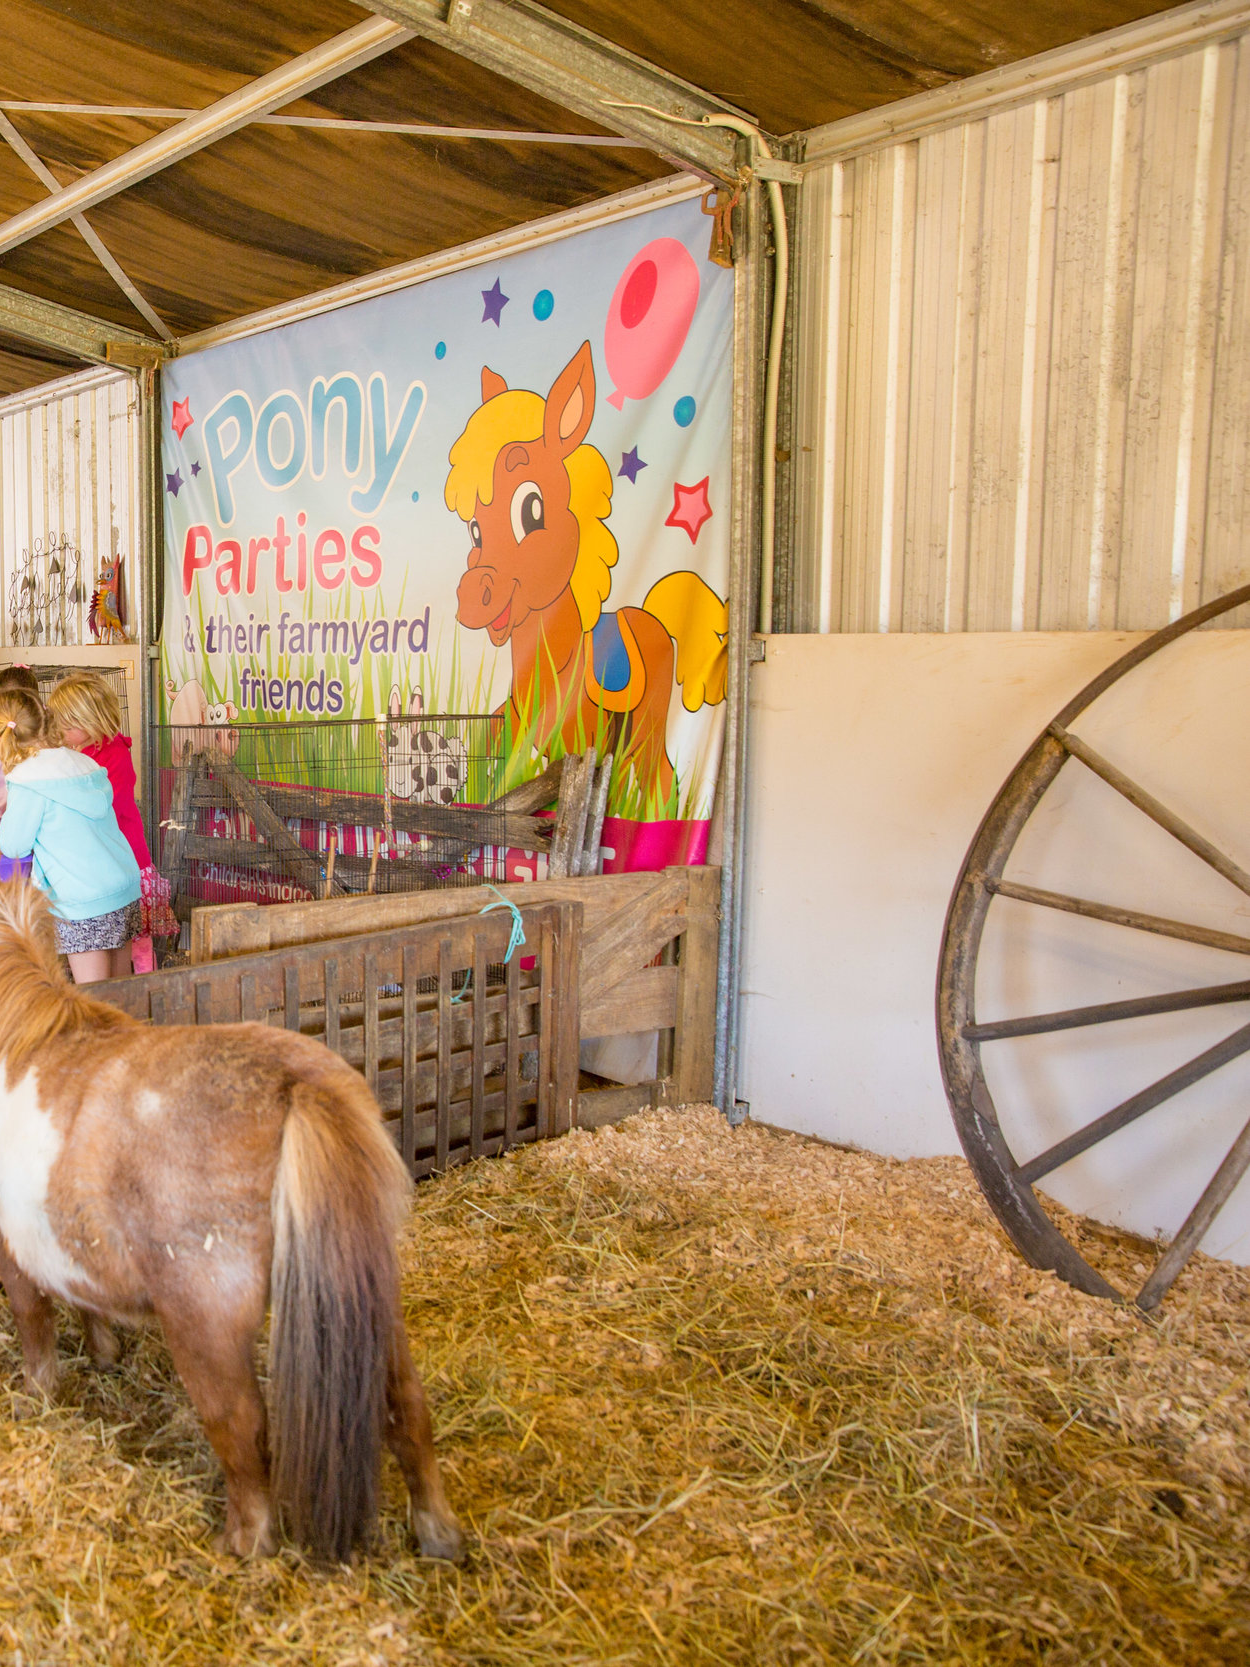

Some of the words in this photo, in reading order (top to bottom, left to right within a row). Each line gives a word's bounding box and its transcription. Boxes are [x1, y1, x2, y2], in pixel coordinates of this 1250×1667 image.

[182, 511, 383, 597] Parties
[184, 615, 196, 653] &
[205, 614, 270, 654] their
[277, 606, 431, 666] farmyard
[240, 668, 344, 713] friends
